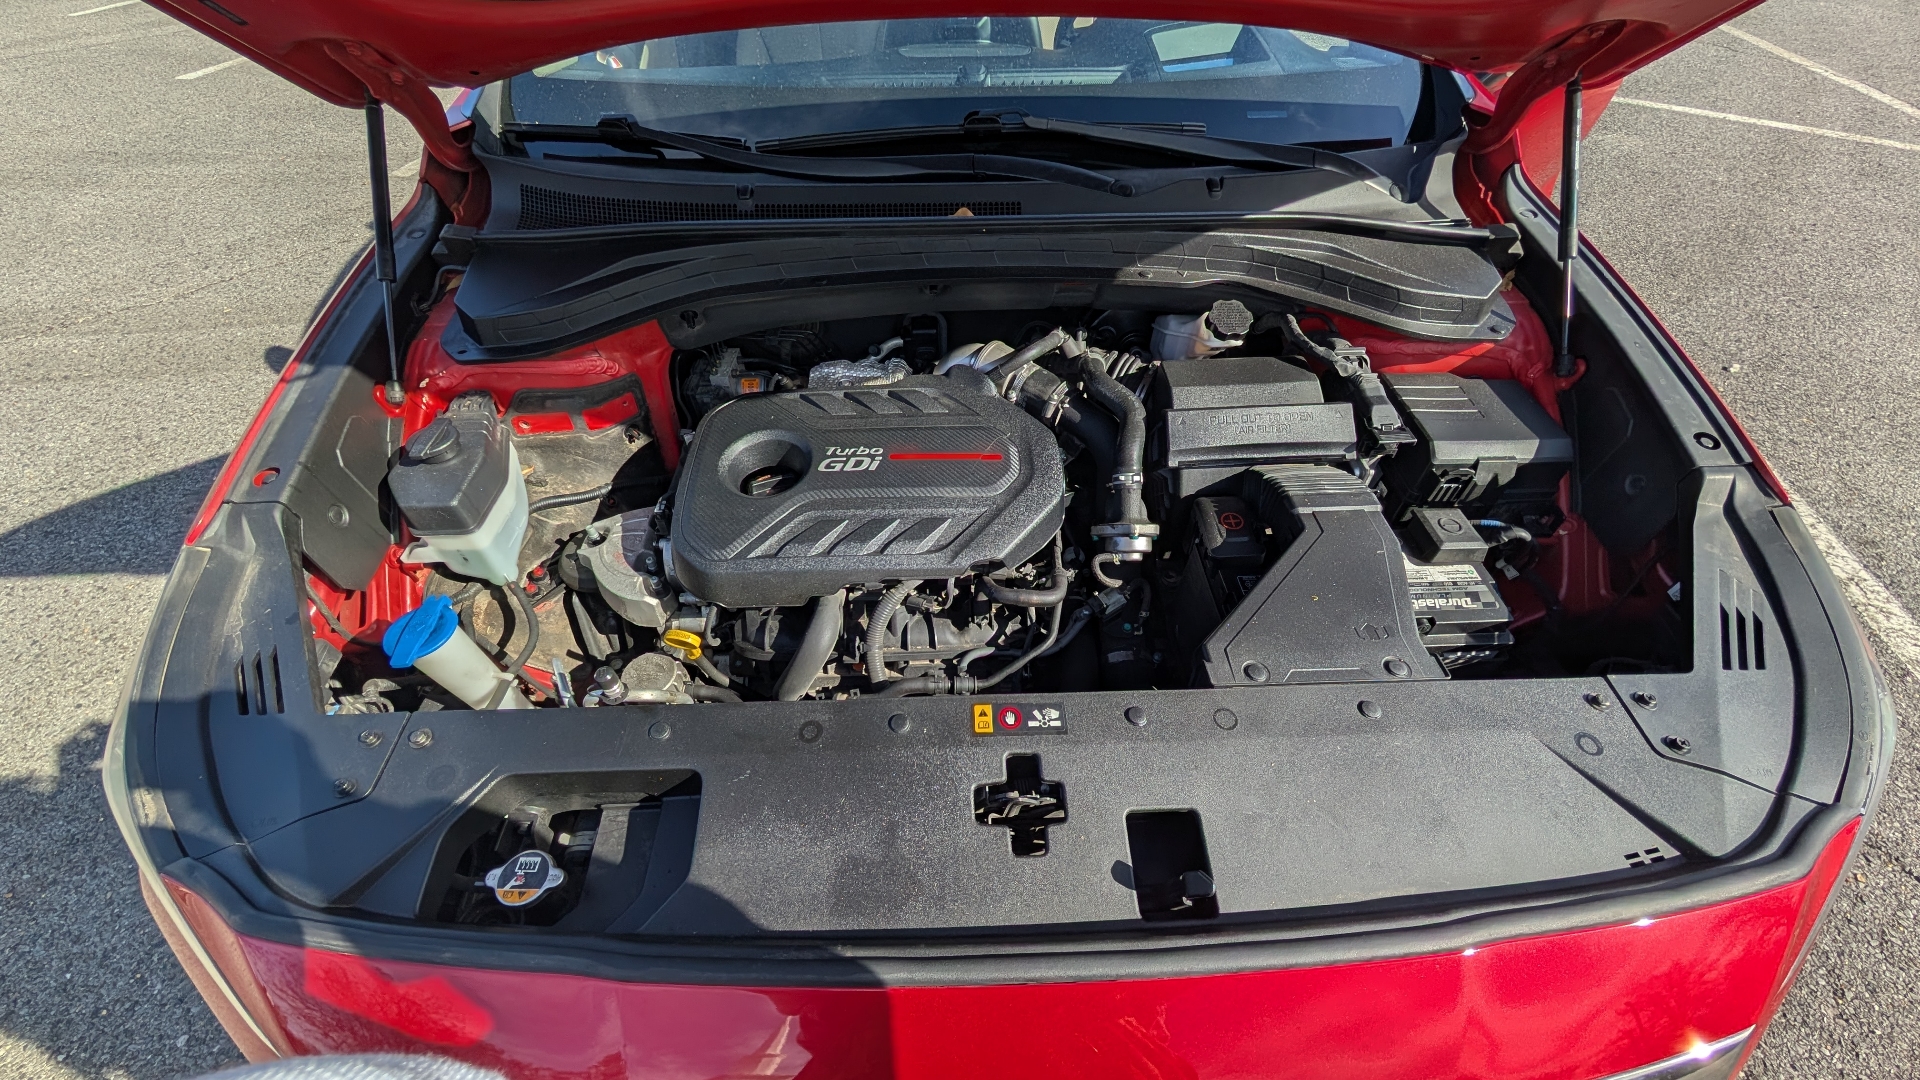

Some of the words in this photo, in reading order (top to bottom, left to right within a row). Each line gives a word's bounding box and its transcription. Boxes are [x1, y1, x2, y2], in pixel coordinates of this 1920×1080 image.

[1209, 414, 1238, 425] PULL
[1241, 413, 1262, 424] OUT
[1266, 412, 1280, 422] TO
[1284, 411, 1314, 421] OPEN
[825, 446, 884, 455] Turbo
[817, 456, 883, 472] GDi
[1411, 597, 1478, 610] Duralast
